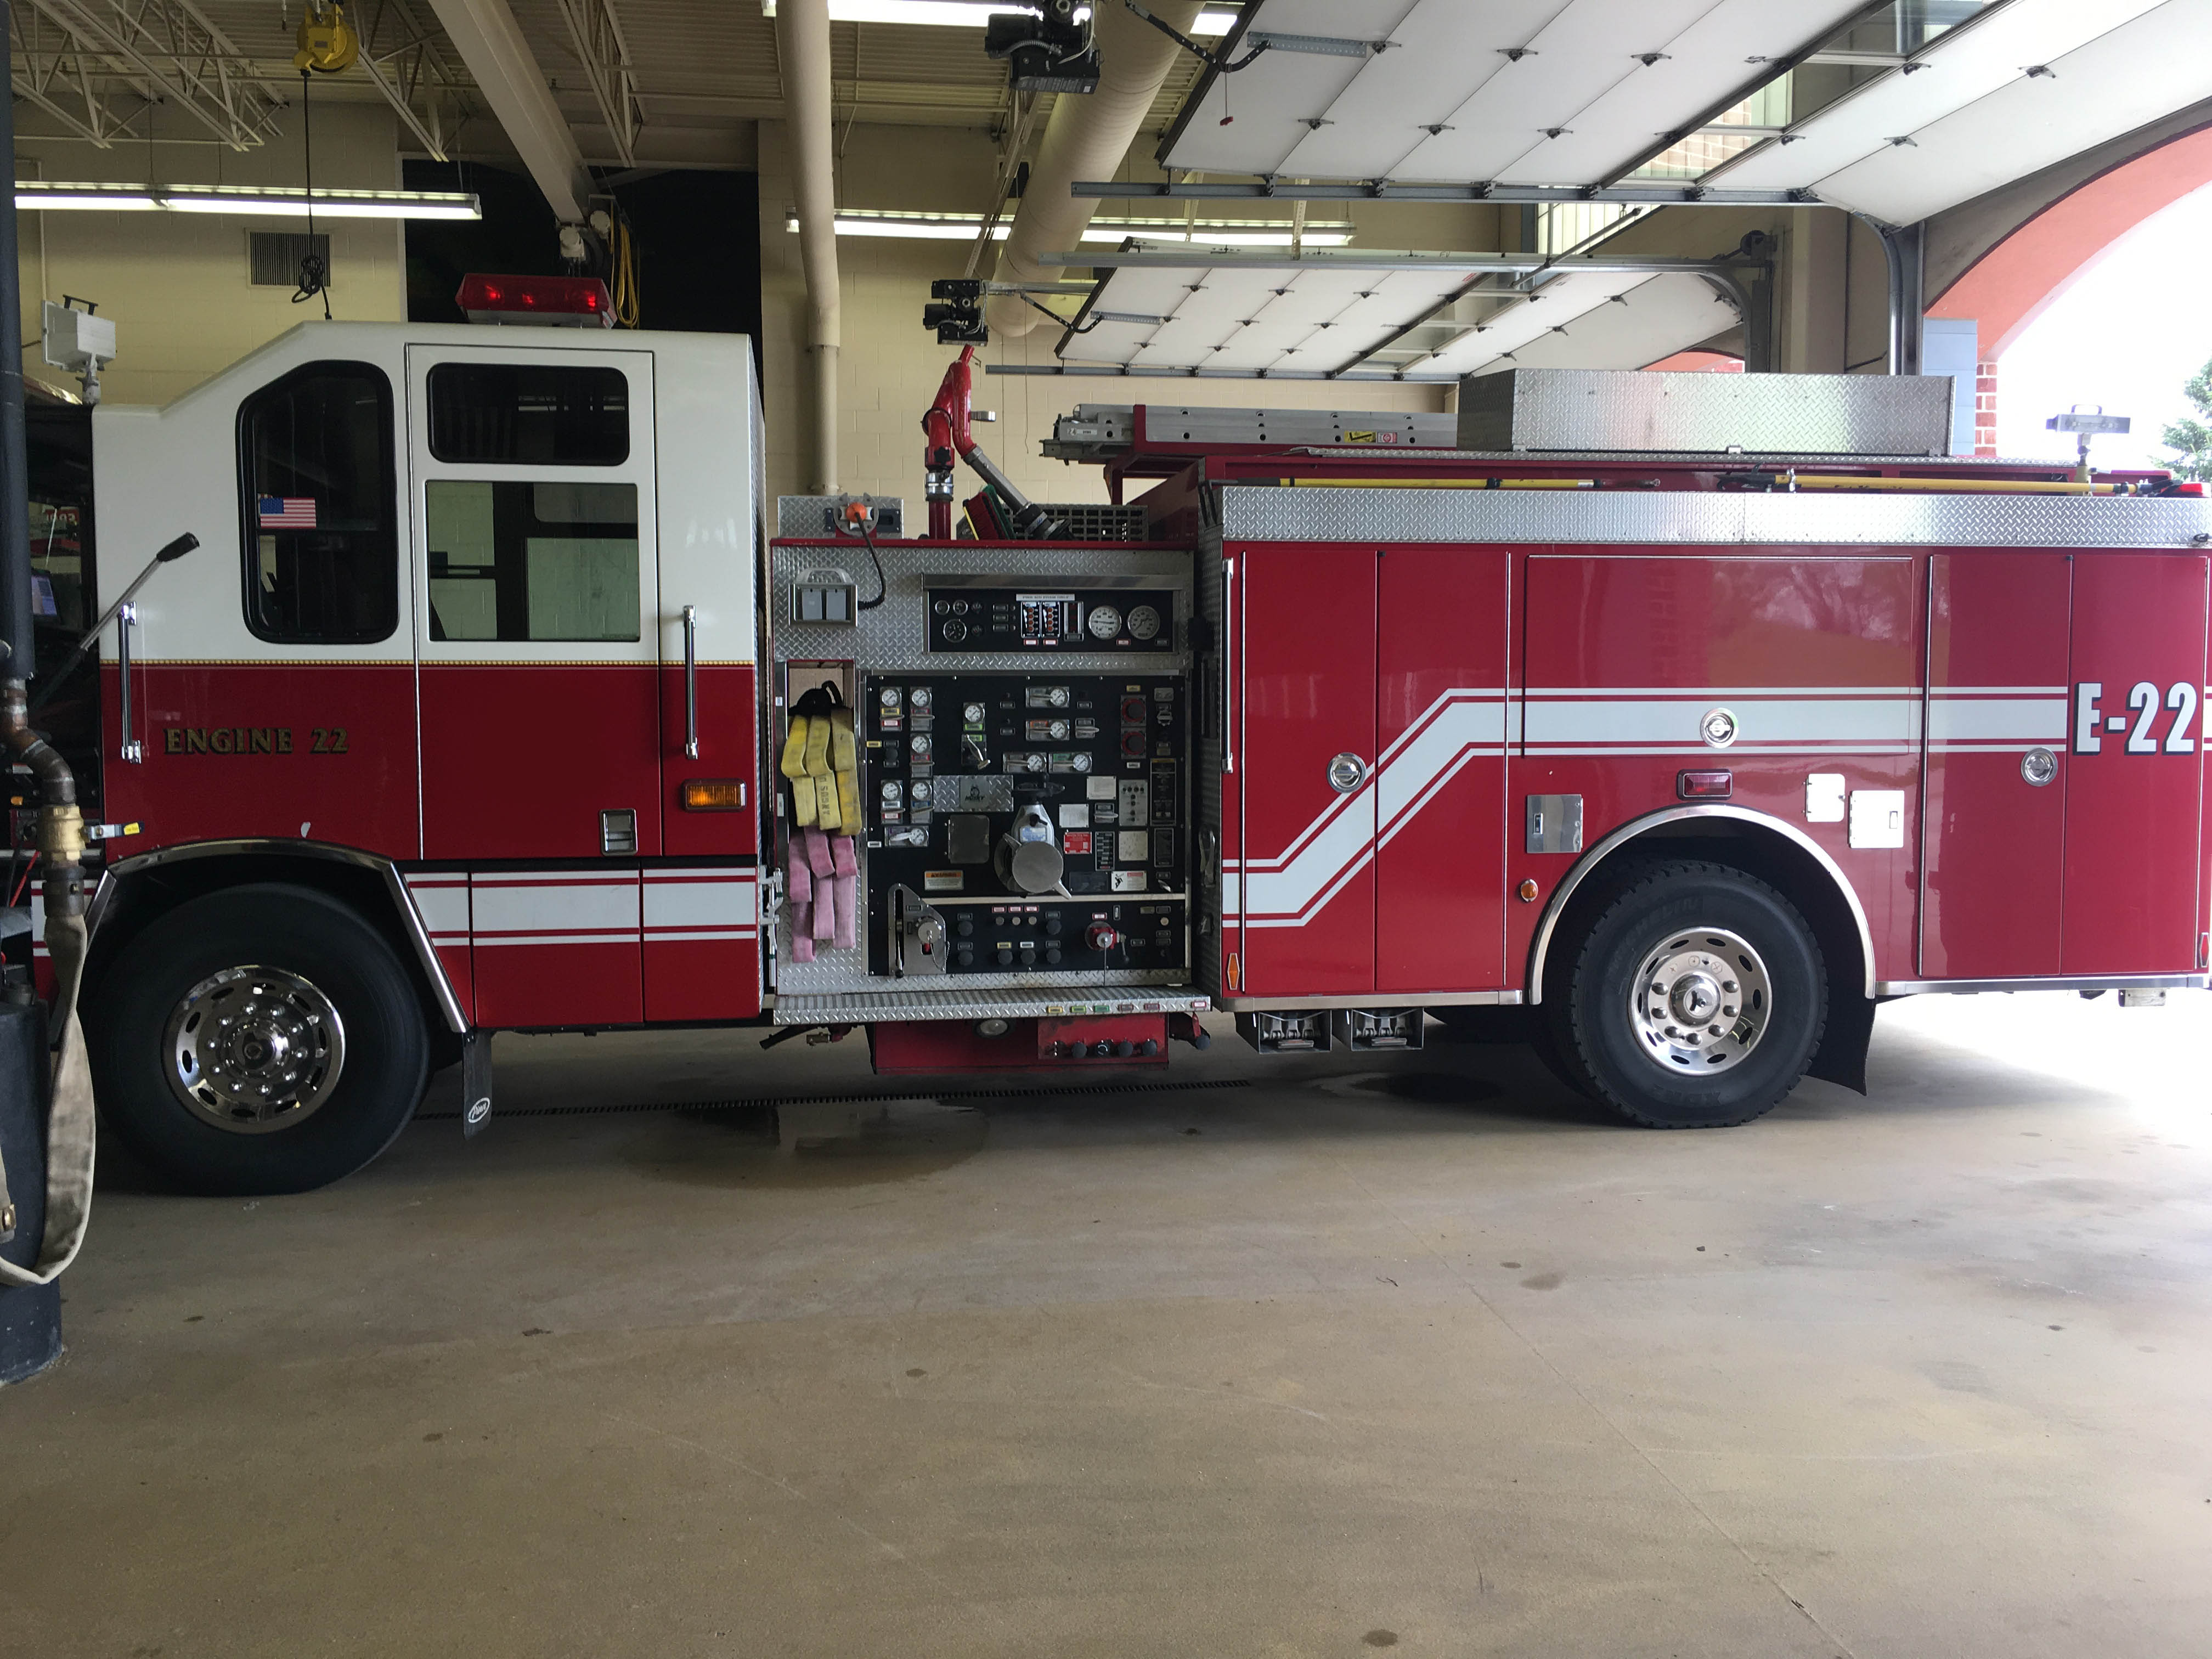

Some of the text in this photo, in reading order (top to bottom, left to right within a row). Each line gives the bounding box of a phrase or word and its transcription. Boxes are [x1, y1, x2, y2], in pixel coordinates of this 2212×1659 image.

[163, 727, 349, 755] ENGINE 22
[2073, 680, 2197, 756] E-22
